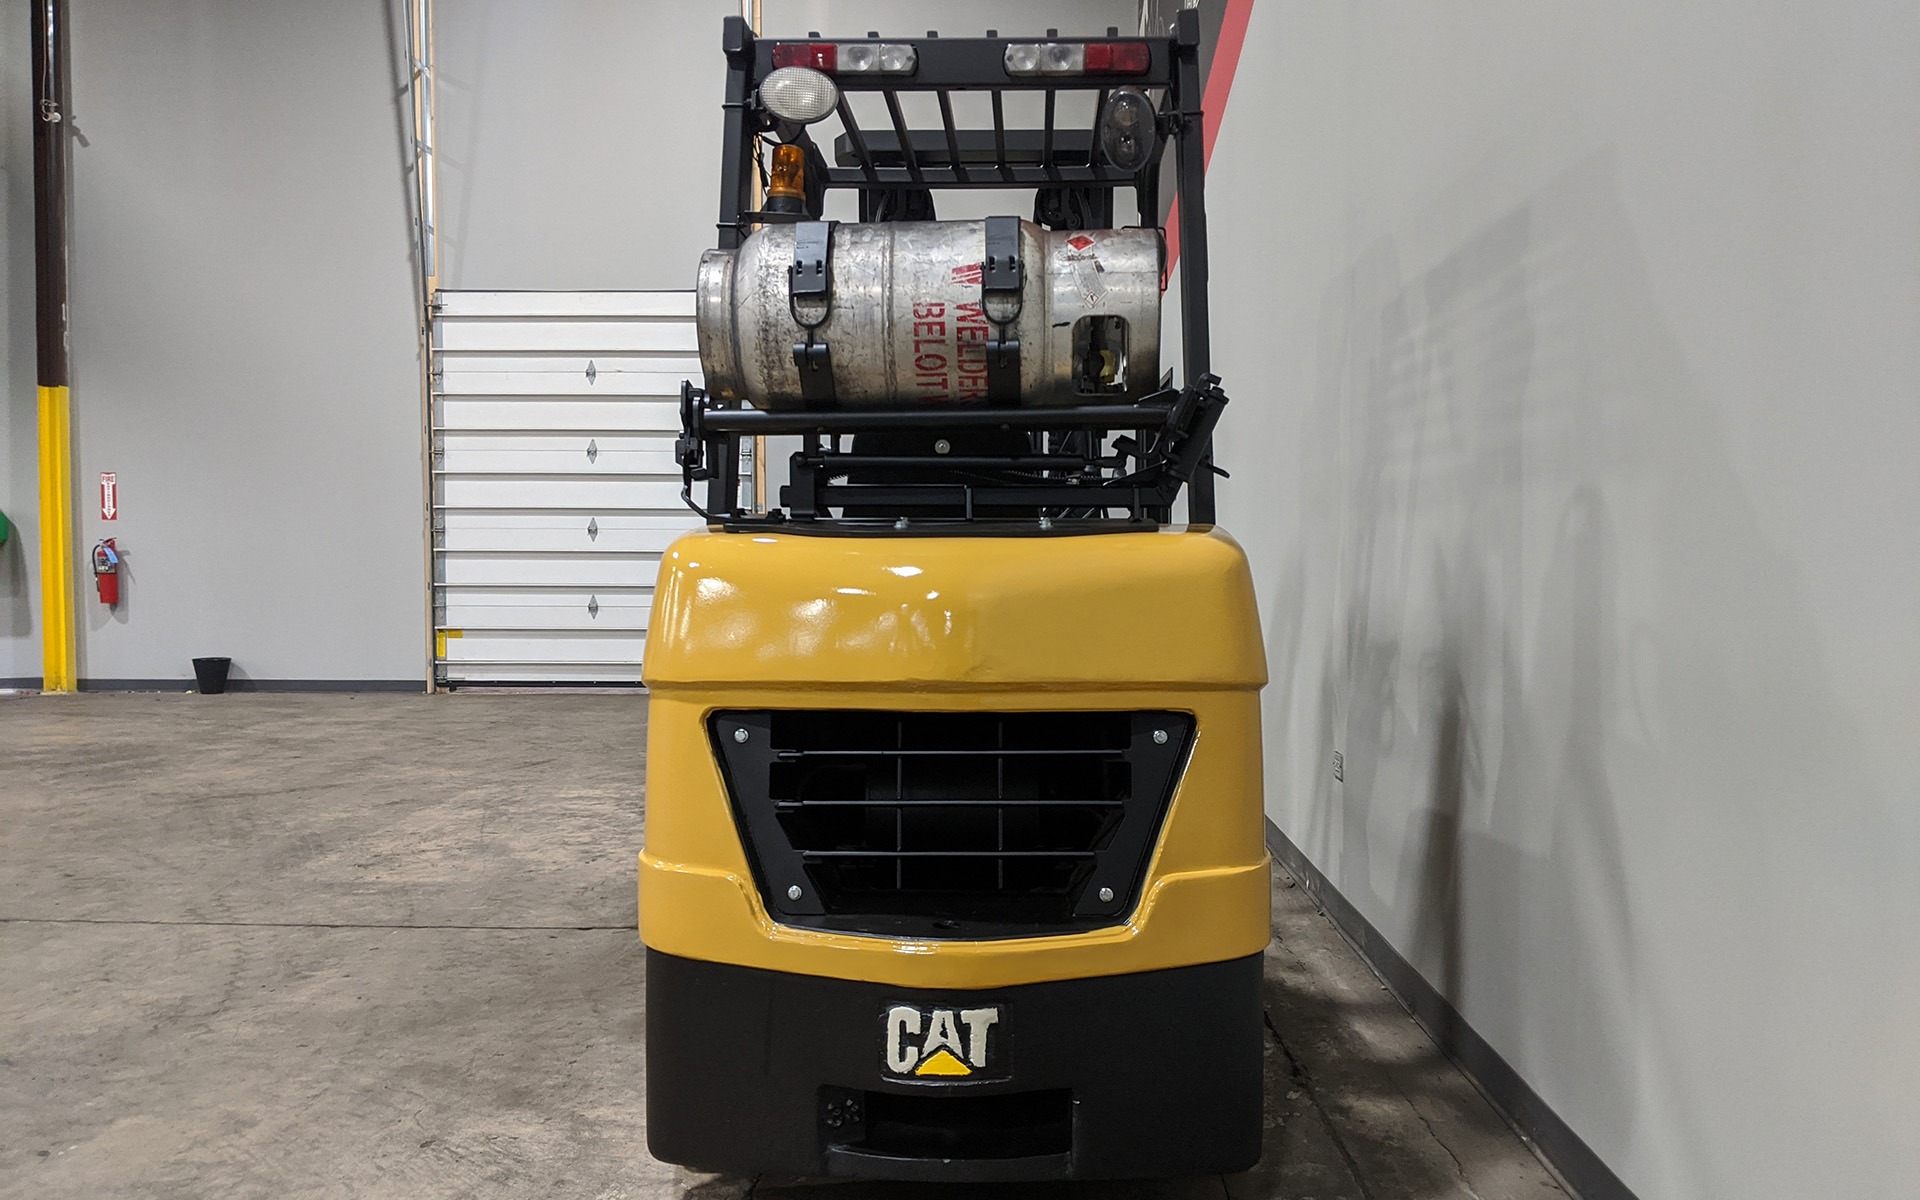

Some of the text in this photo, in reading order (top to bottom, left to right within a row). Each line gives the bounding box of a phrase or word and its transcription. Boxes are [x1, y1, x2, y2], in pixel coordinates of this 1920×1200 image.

[912, 302, 949, 390] BELOIT
[102, 475, 115, 483] FIRE
[886, 1005, 999, 1074] CAT
